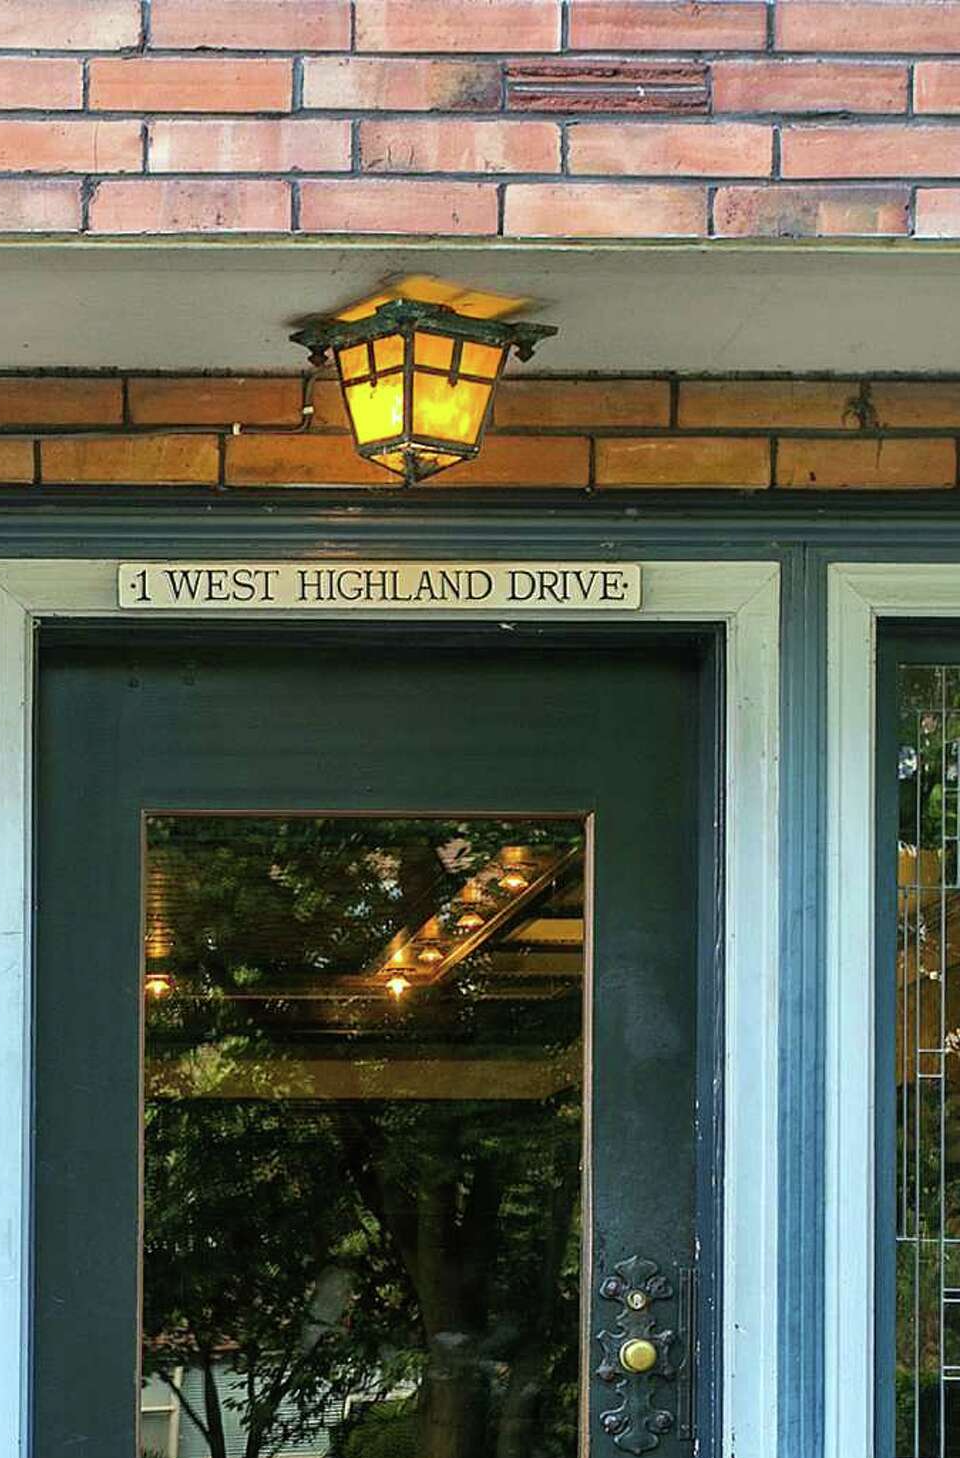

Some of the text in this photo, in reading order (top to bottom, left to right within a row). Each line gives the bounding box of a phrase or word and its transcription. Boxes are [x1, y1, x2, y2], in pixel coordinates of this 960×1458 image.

[165, 569, 279, 601] WEST
[297, 569, 493, 602] HIGHLAND
[506, 570, 626, 603] DRIVE
